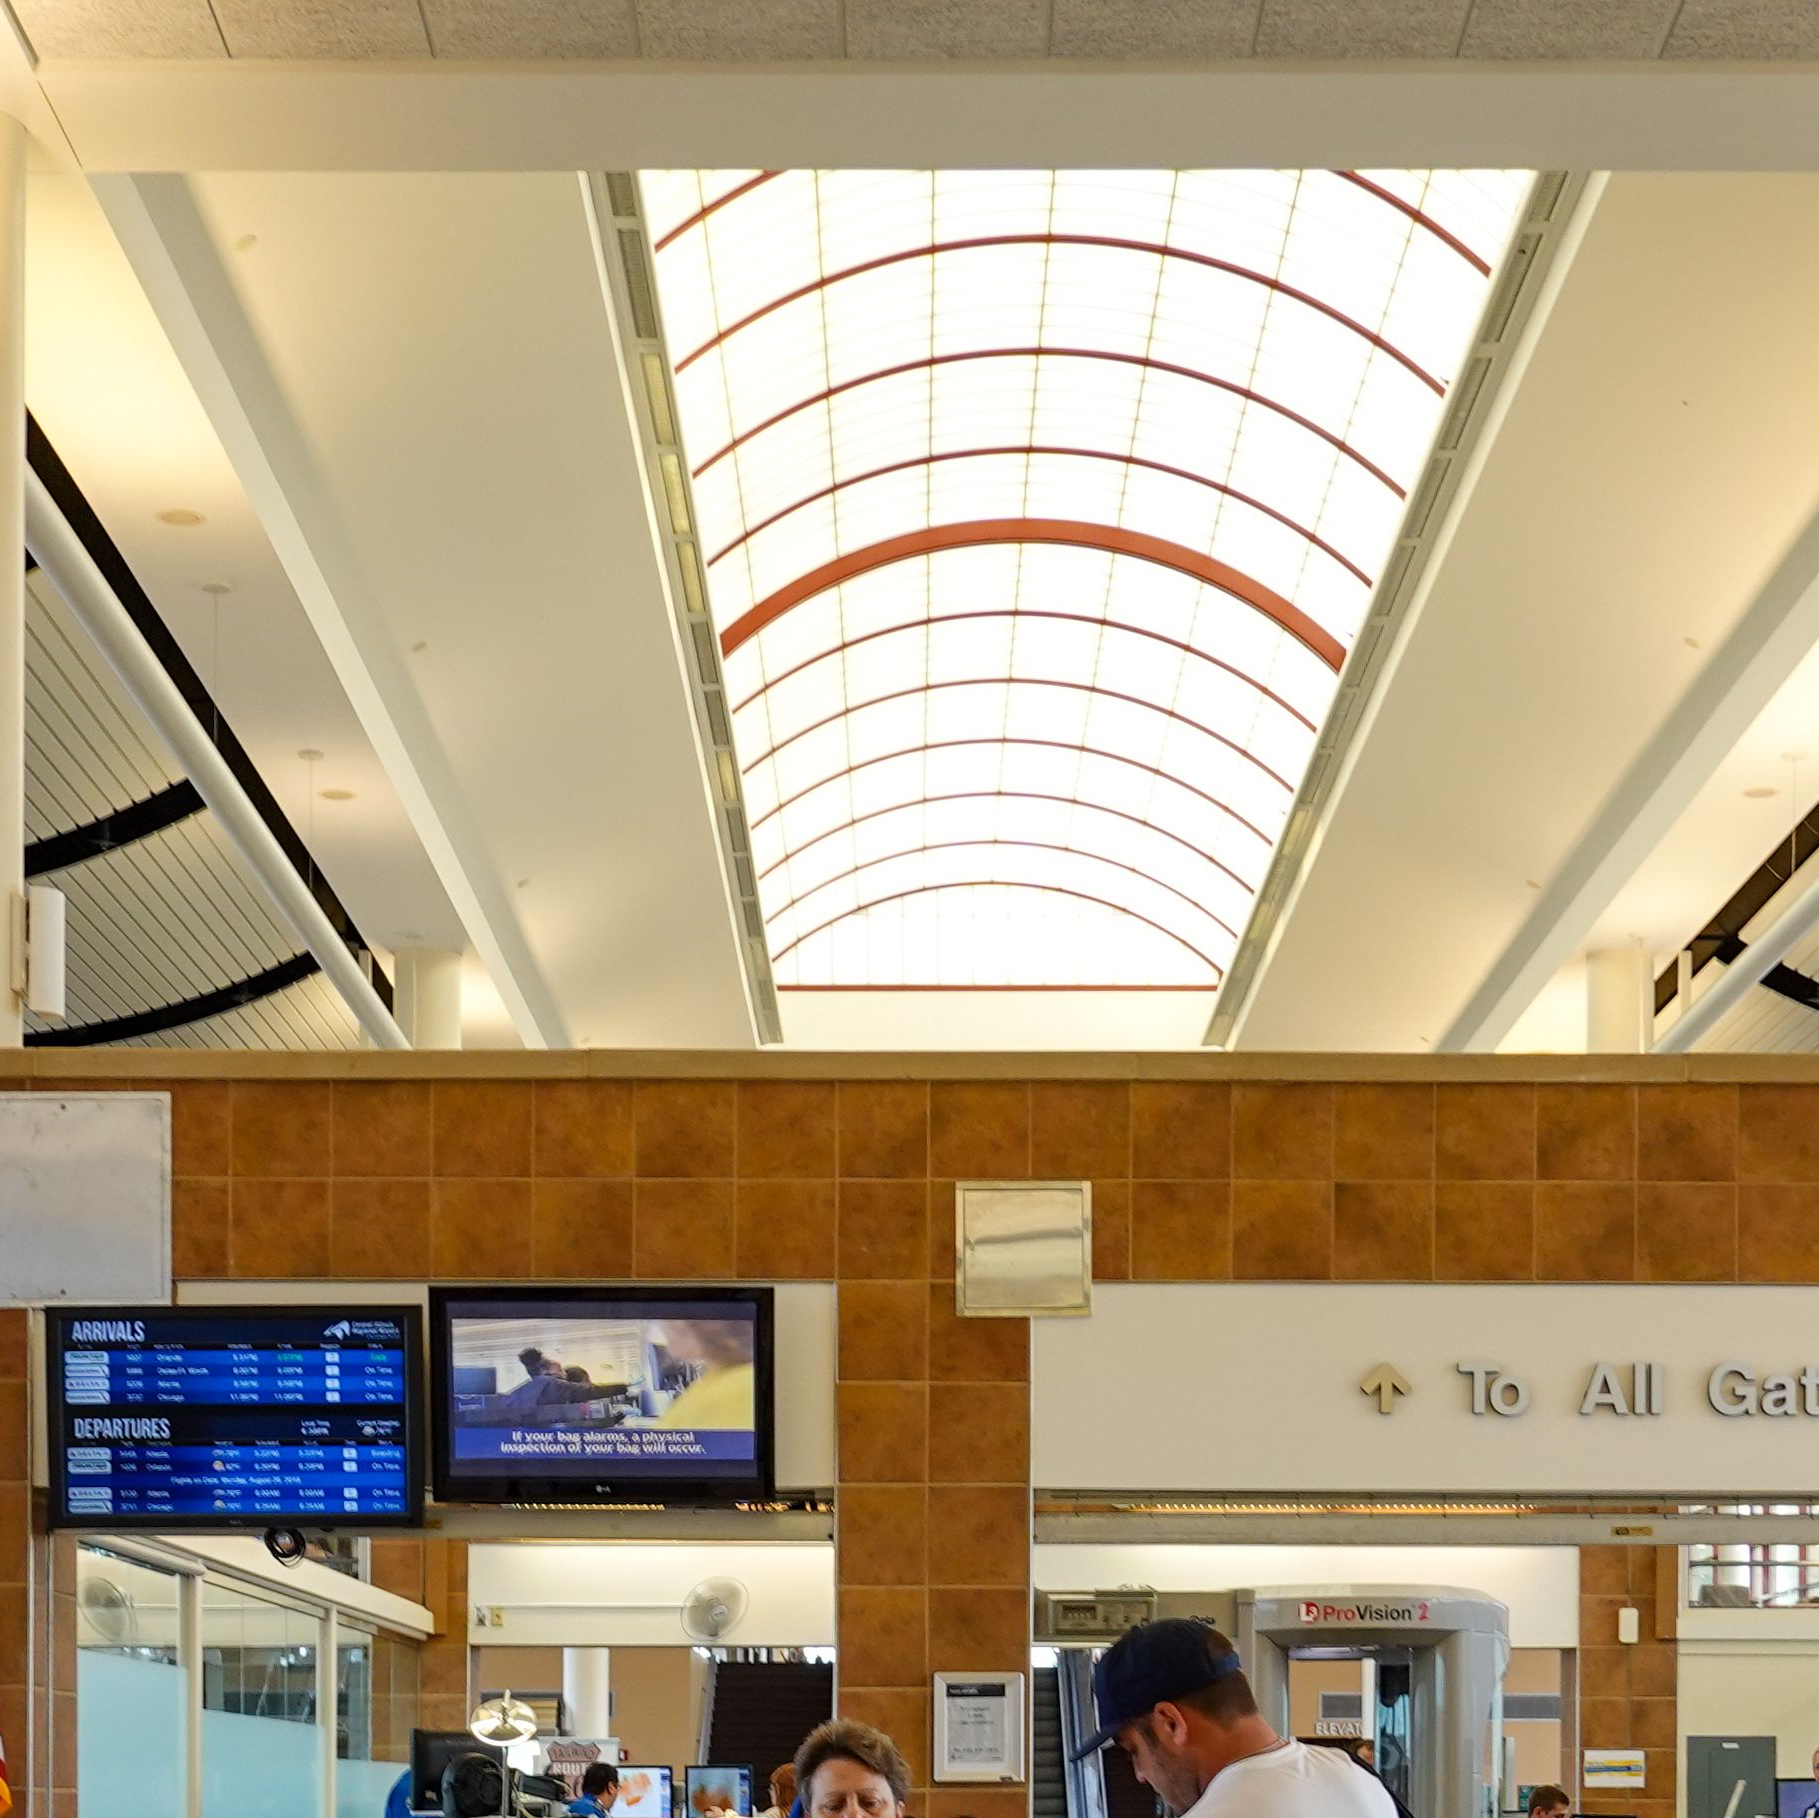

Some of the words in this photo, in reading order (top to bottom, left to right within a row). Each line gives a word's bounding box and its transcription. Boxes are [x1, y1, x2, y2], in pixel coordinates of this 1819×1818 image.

[71, 1322, 145, 1341] ARRIVALS
[1457, 1361, 1531, 1417] To
[1580, 1361, 1663, 1417] All
[74, 1419, 171, 1439] DEPARTURES
[512, 1431, 522, 1441] If
[526, 1432, 553, 1443] your
[558, 1431, 580, 1443] bag
[583, 1431, 628, 1443] alarms,
[632, 1433, 639, 1441] a
[642, 1431, 695, 1443] physical
[568, 1442, 582, 1451] of
[584, 1444, 612, 1455] your
[617, 1442, 639, 1455] bag
[643, 1442, 666, 1453] will
[1323, 1603, 1412, 1622] ProVision
[552, 1762, 586, 1776] ROUT
